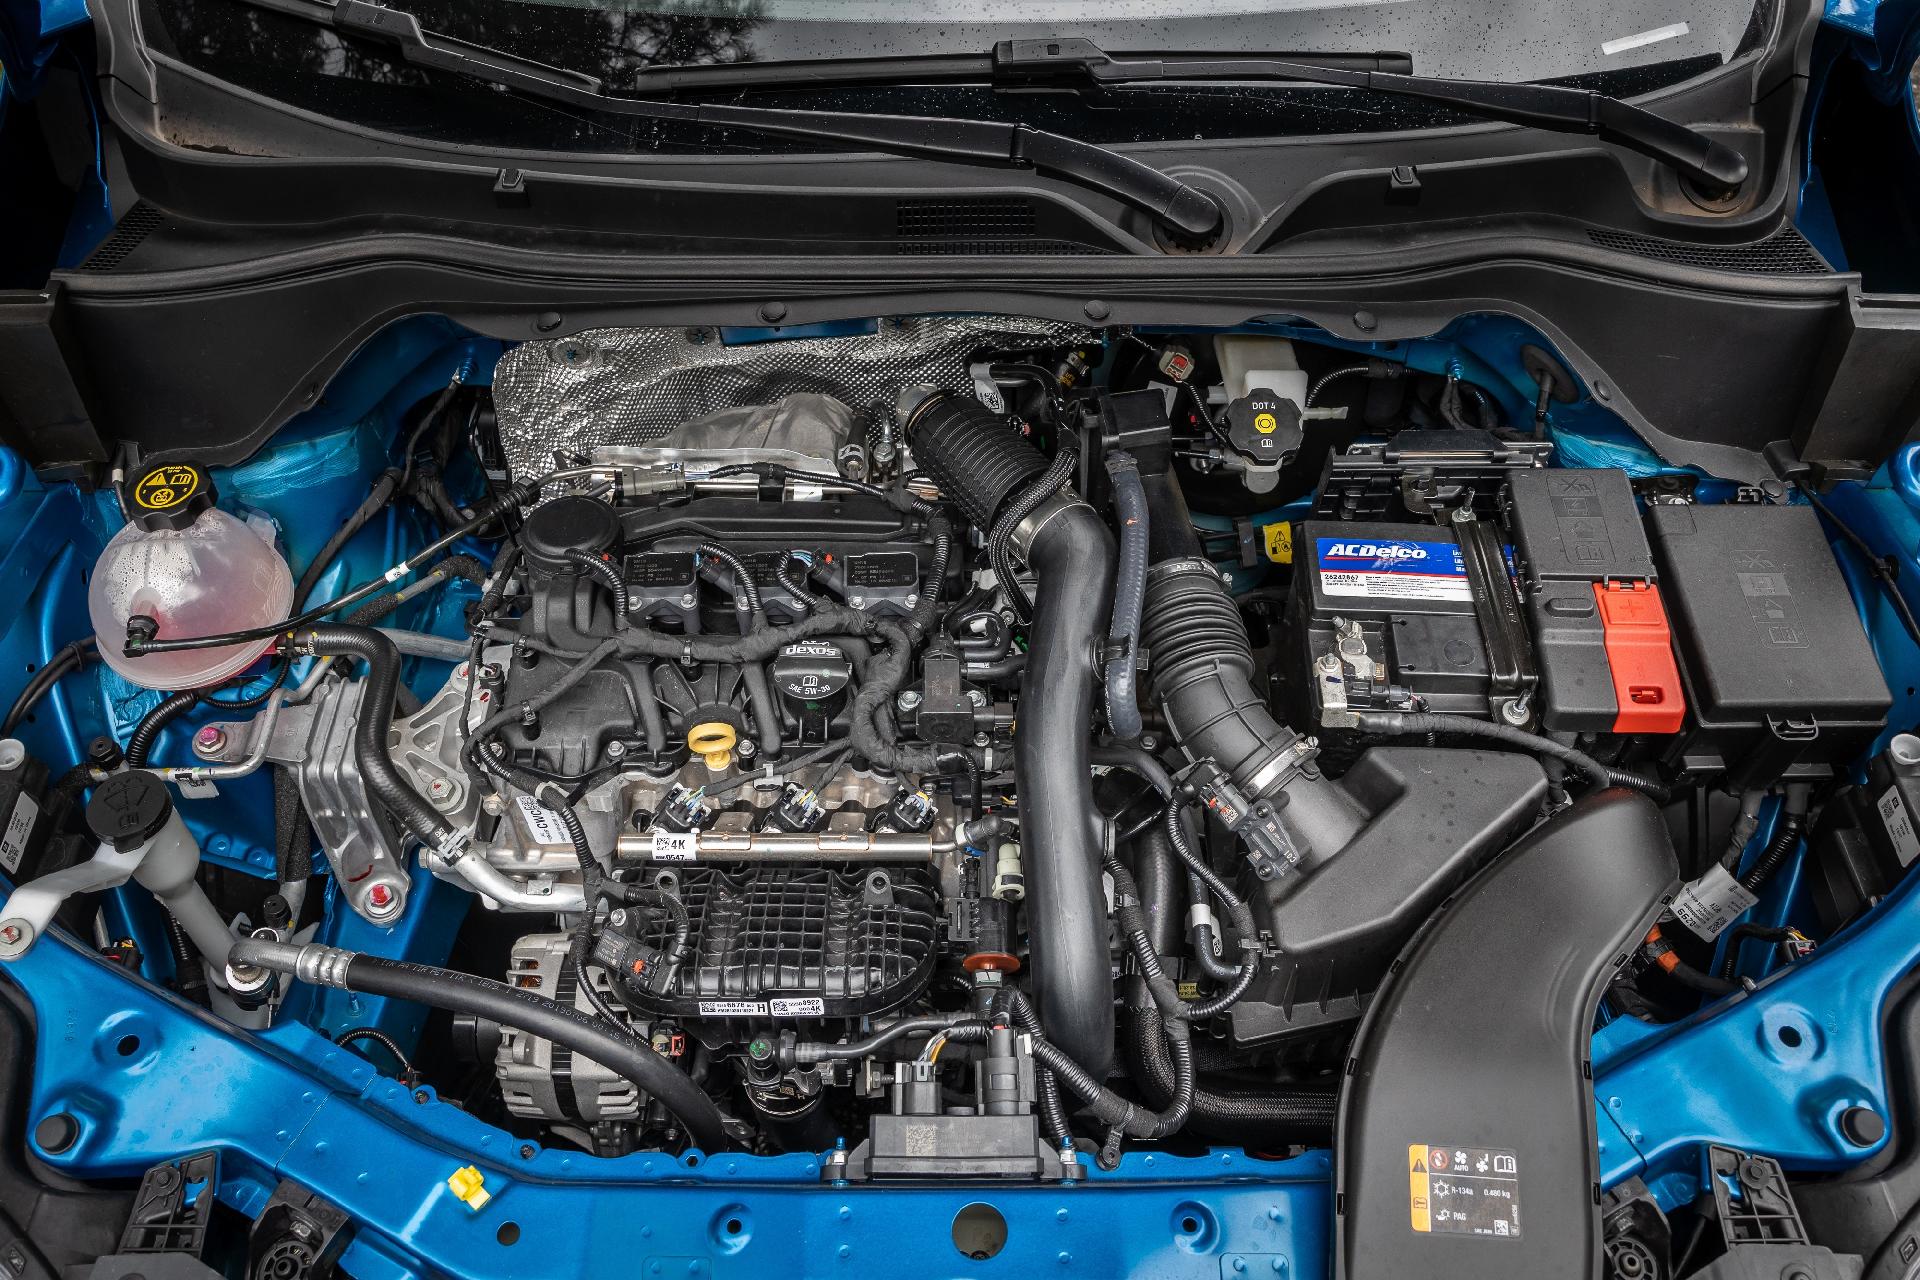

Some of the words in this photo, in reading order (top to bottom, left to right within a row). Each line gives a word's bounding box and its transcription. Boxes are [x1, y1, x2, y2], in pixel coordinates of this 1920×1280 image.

[1252, 402, 1269, 410] DOT
[1270, 402, 1276, 410] 4
[1327, 543, 1427, 559] ACDelco
[786, 645, 836, 656] dexos
[788, 683, 804, 694] SAE
[804, 685, 831, 695] 5W-30
[671, 839, 686, 850] 4K
[757, 1003, 766, 1013] H
[1454, 1164, 1469, 1172] AUTO
[1453, 1212, 1467, 1221] PAG
